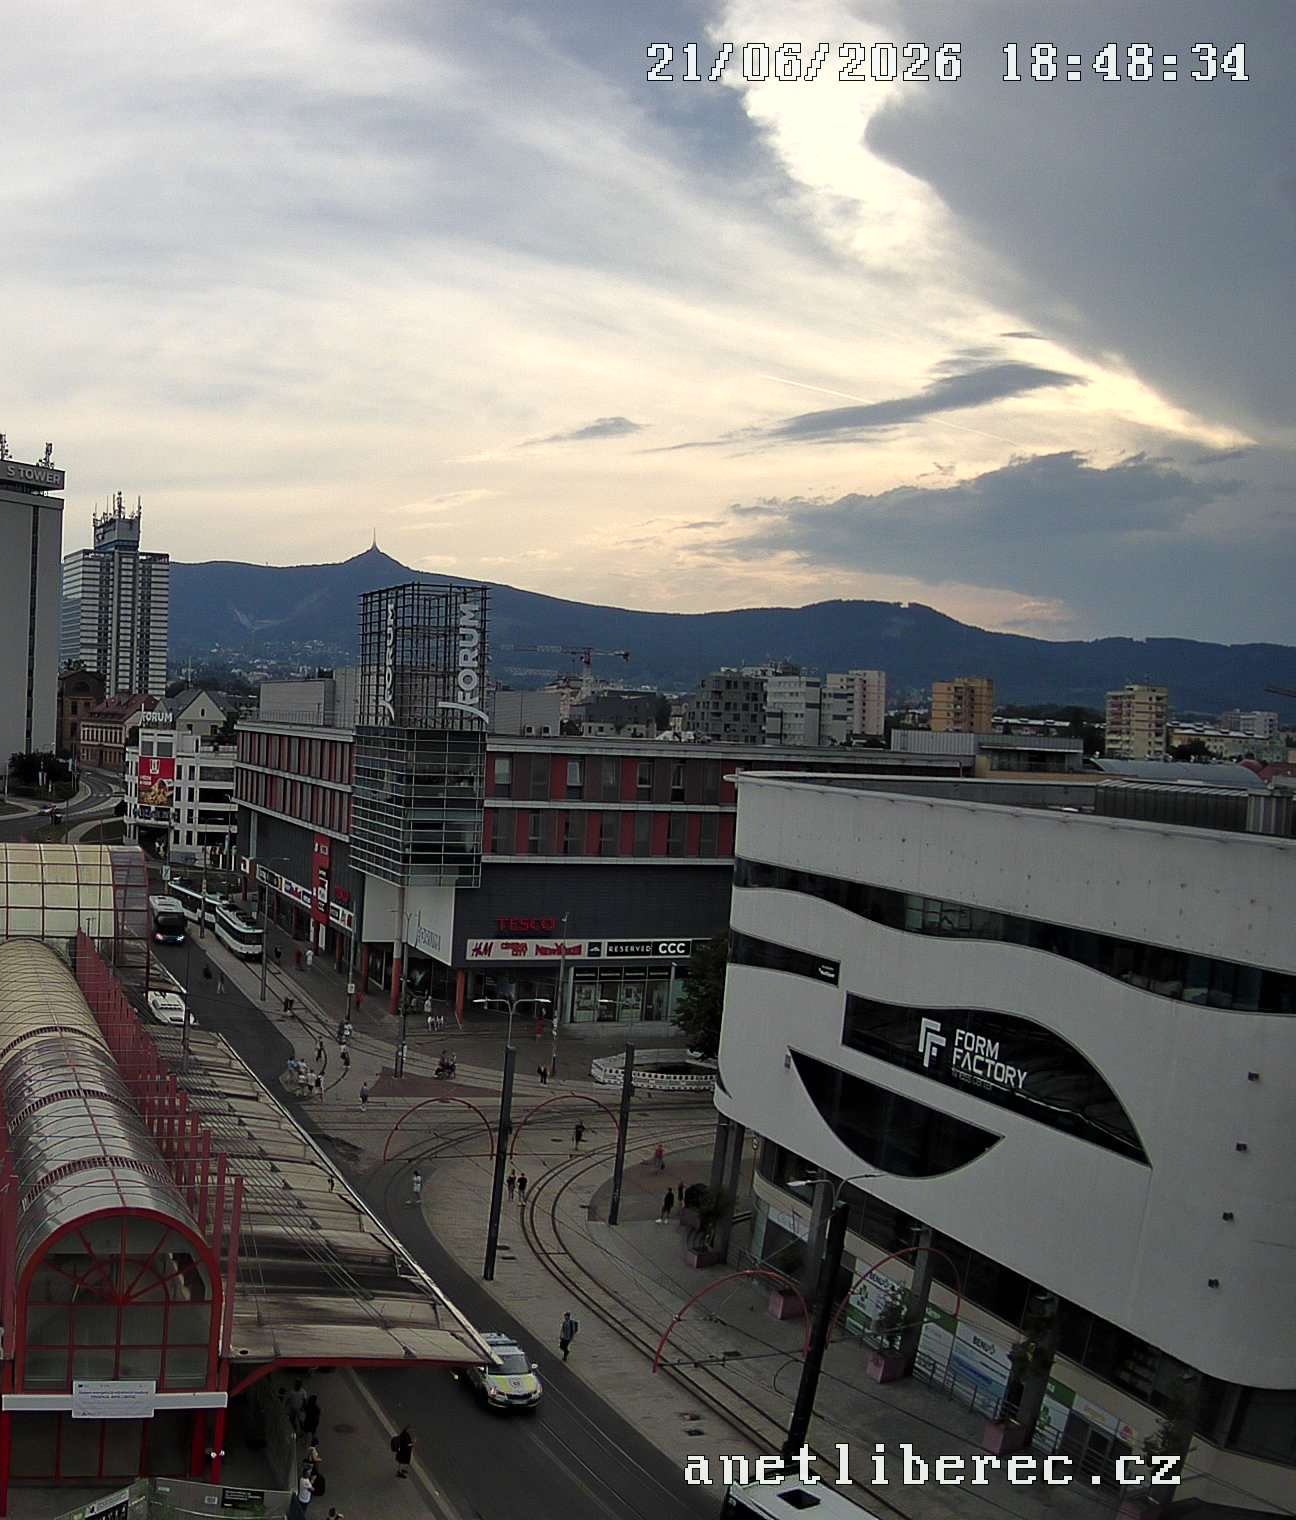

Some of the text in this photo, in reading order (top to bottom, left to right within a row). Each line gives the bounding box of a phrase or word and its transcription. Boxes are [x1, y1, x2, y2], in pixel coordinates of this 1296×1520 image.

[7, 466, 62, 484] S TOWER
[496, 917, 557, 932] TESCO
[658, 943, 686, 954] CCC
[955, 1028, 1000, 1060] FORM
[952, 1047, 1028, 1089] FACTORY
